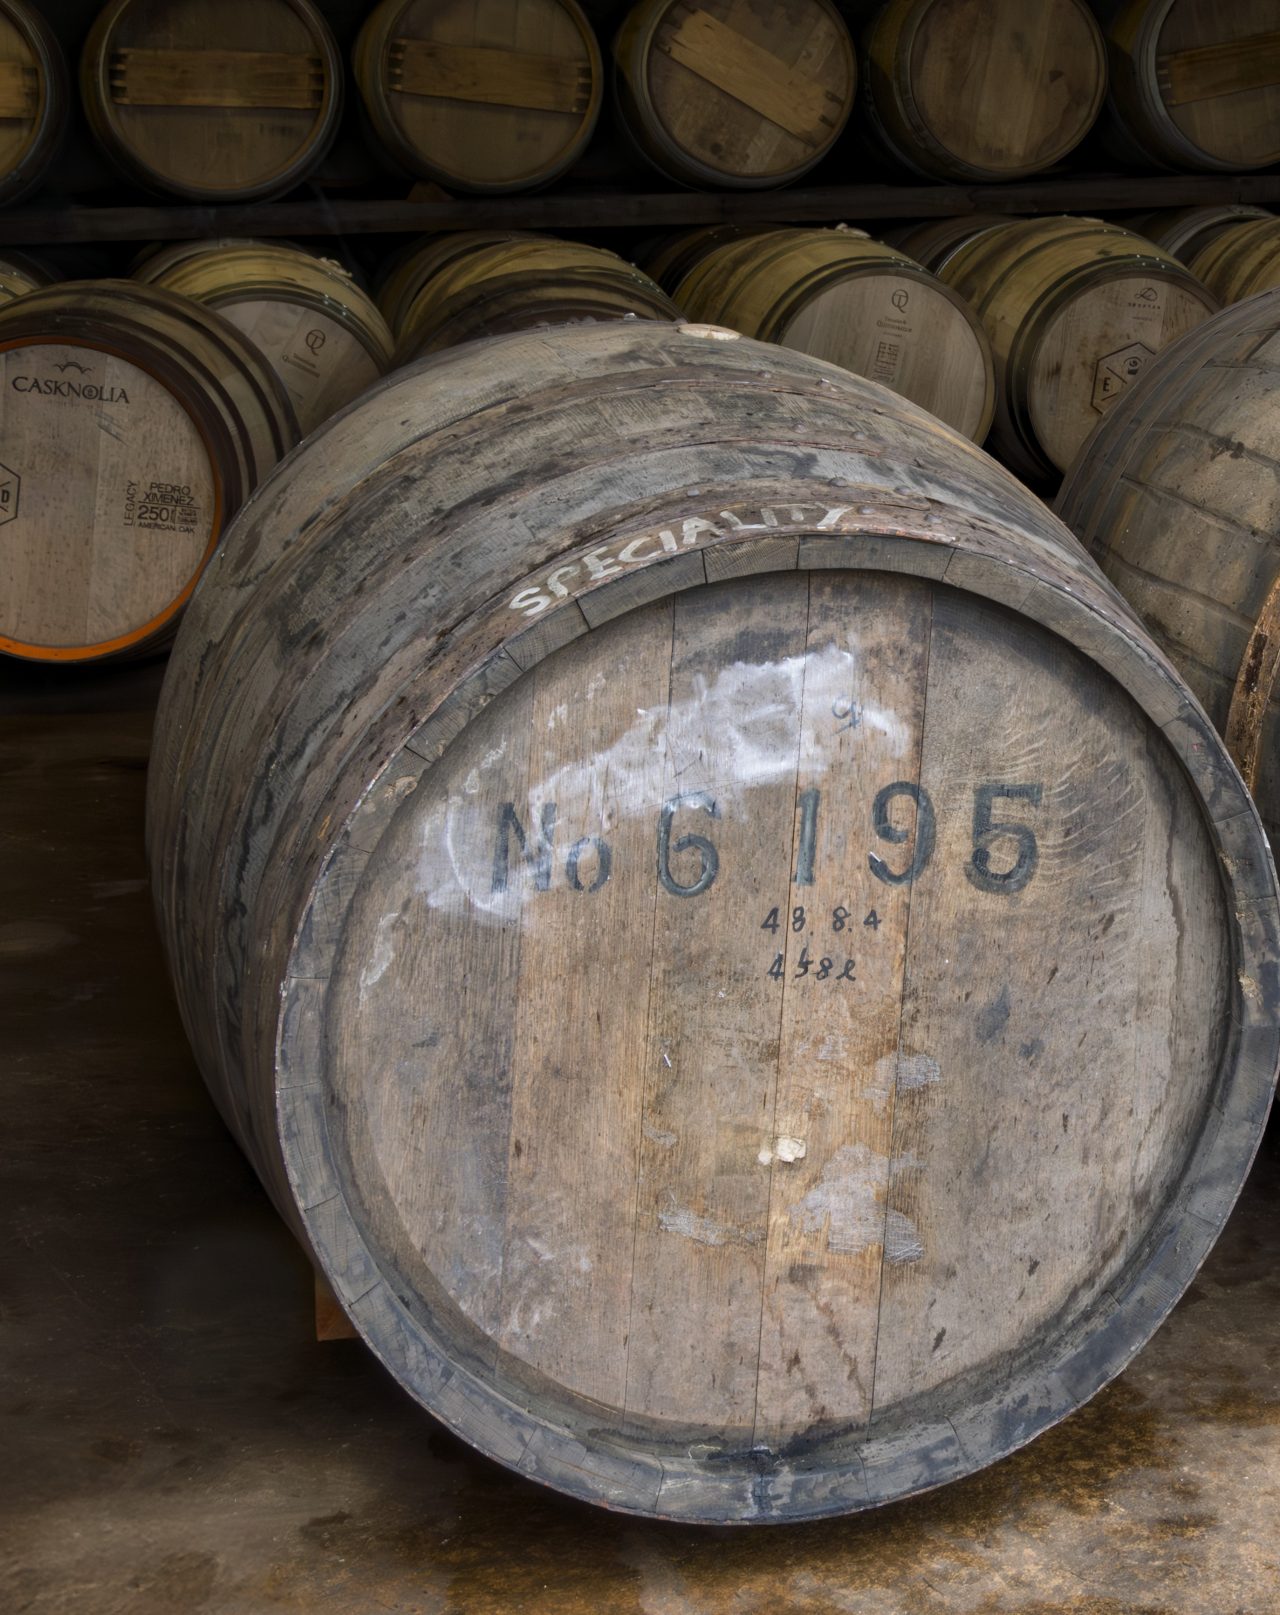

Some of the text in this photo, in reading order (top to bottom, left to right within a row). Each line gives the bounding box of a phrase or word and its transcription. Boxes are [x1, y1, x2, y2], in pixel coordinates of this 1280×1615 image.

[11, 376, 131, 405] CASKNOLIA
[144, 492, 194, 505] XIMENEZ
[149, 482, 191, 496] PEDRO
[125, 480, 138, 526] LEGACY
[137, 505, 170, 522] 250
[508, 502, 854, 618] SPECIALITY
